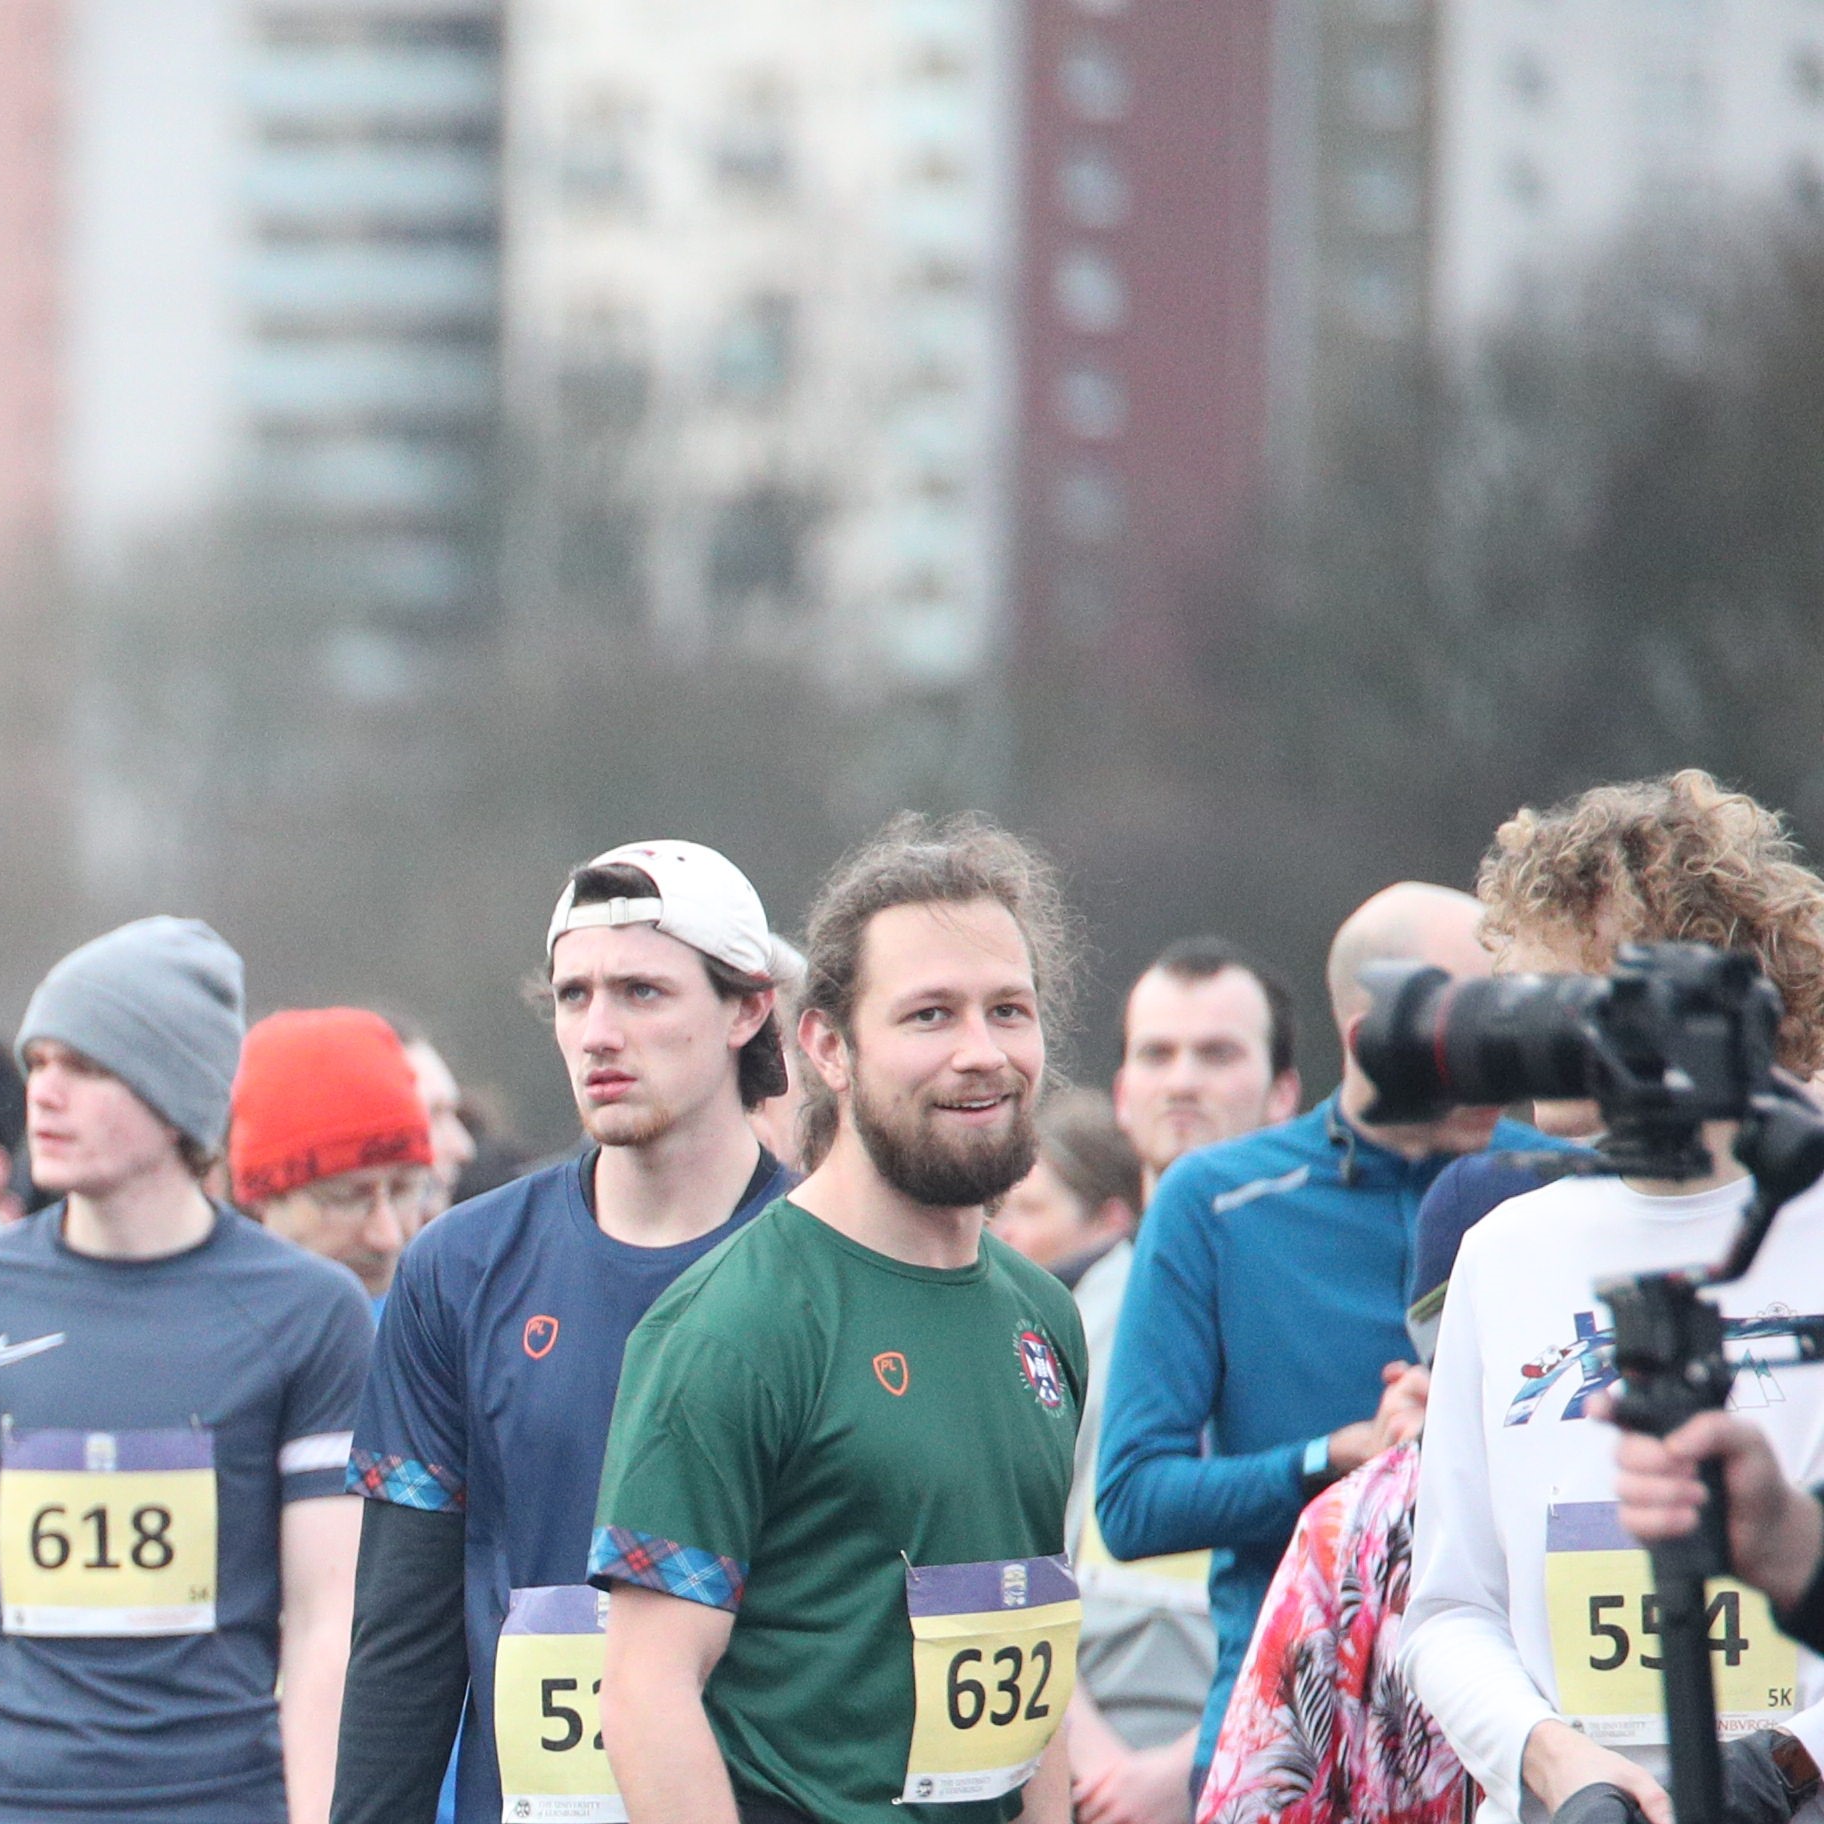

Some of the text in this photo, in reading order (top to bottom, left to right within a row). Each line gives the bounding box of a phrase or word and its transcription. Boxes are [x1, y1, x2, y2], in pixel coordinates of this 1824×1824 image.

[30, 1503, 175, 1571] 618
[1589, 1591, 1749, 1671] 554
[944, 1640, 1052, 1730] 632
[1768, 1687, 1792, 1707] 5K
